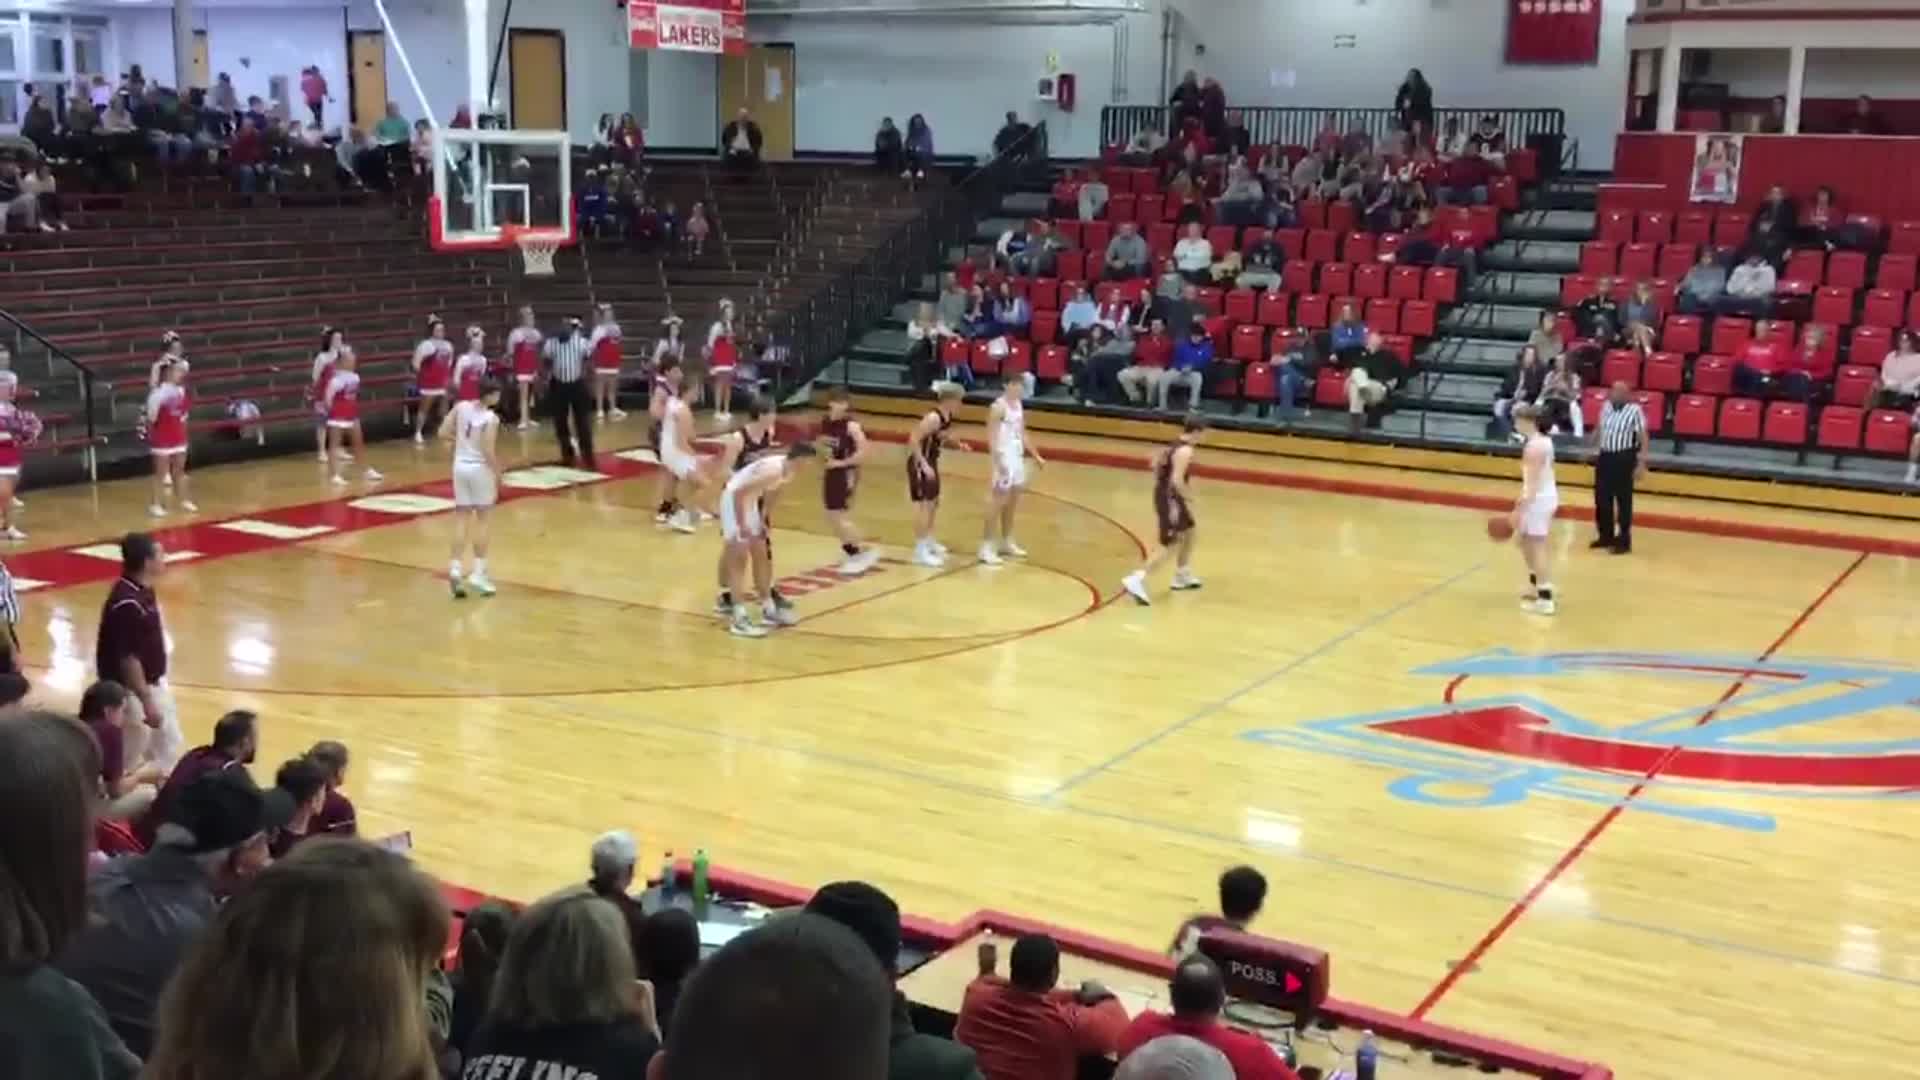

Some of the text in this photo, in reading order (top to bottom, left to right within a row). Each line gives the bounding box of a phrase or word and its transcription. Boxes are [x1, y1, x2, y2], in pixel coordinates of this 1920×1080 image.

[660, 25, 720, 47] LAKERS
[1231, 960, 1281, 986] POSS.
[462, 1054, 598, 1080] EELIN
